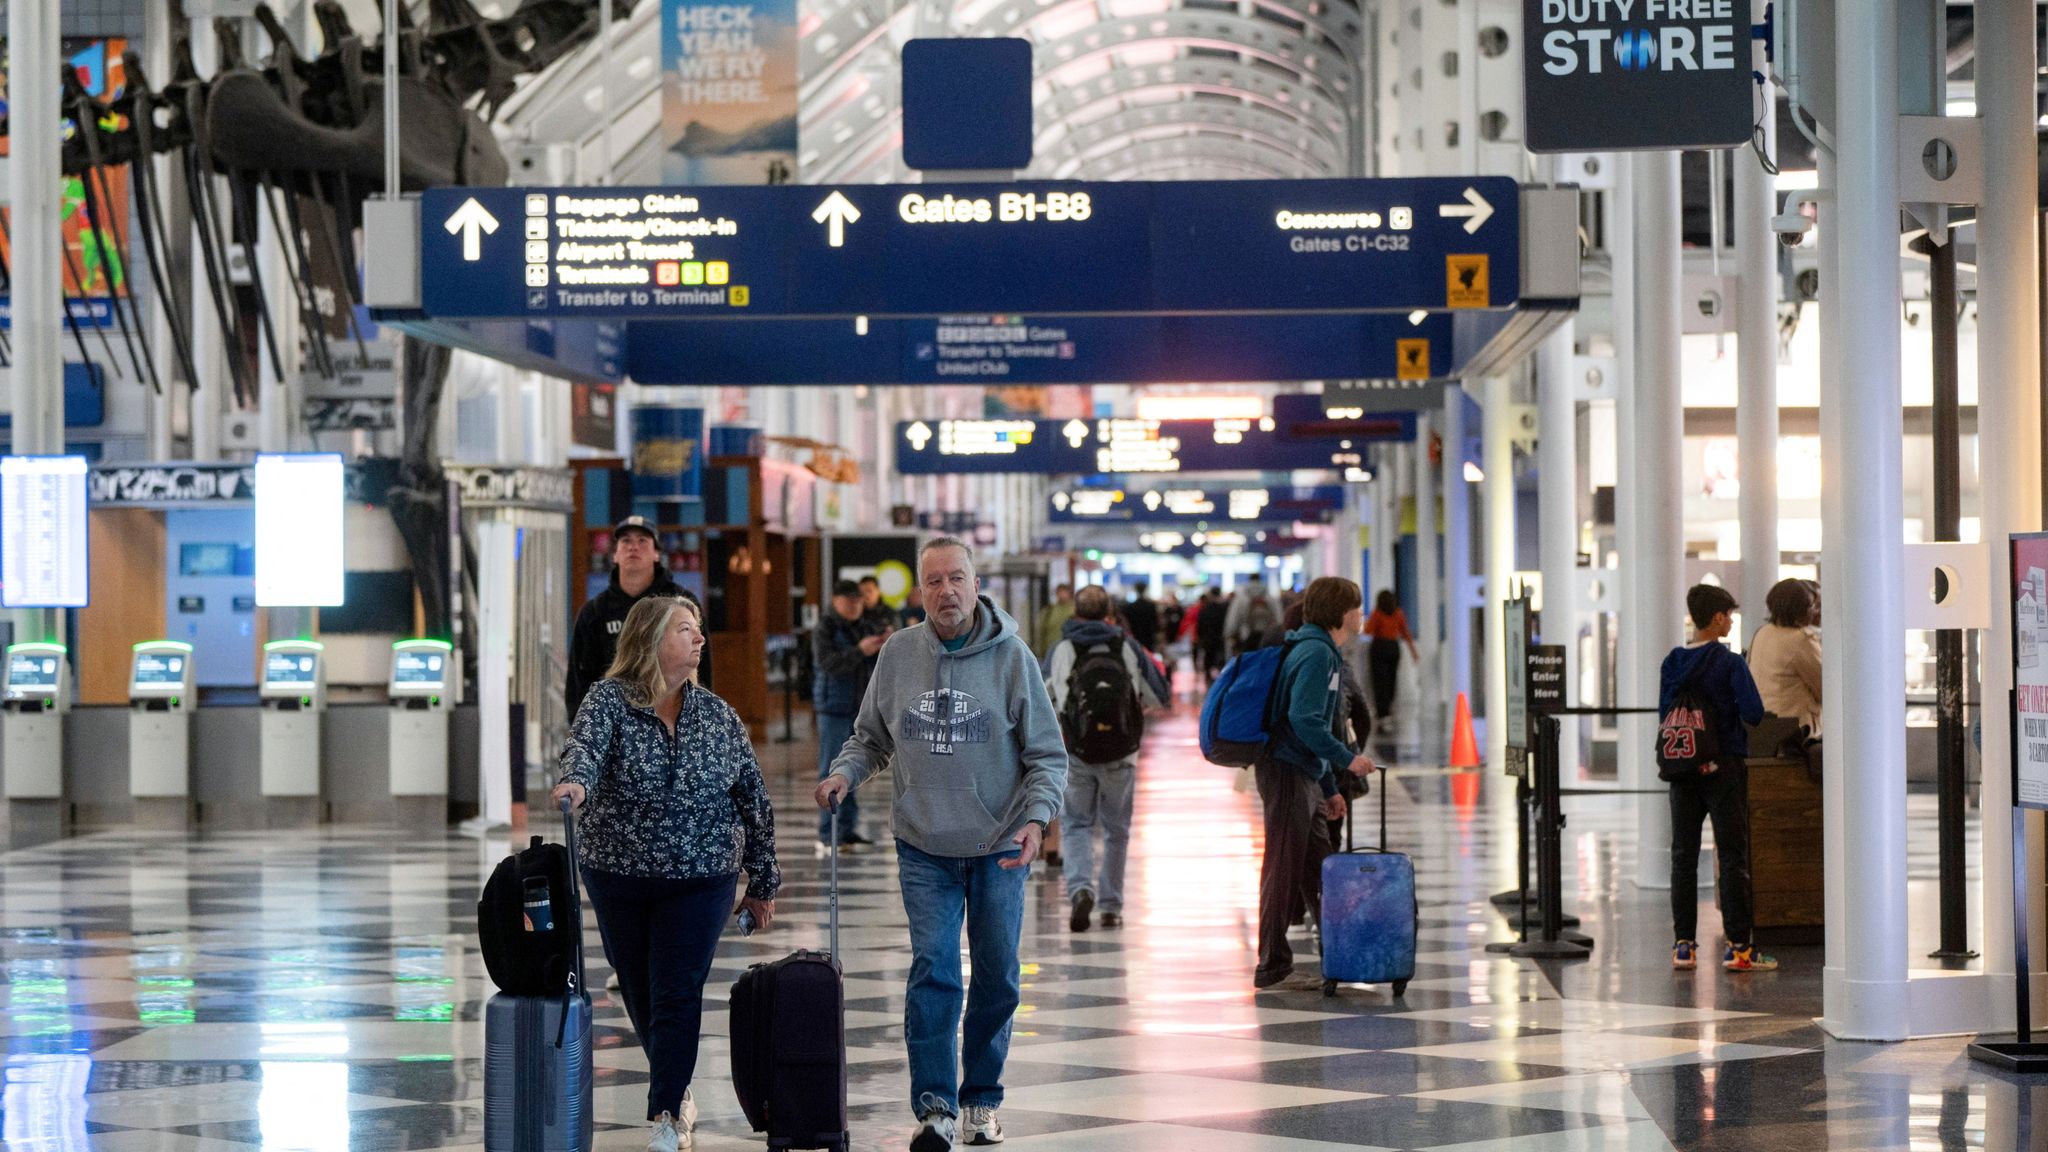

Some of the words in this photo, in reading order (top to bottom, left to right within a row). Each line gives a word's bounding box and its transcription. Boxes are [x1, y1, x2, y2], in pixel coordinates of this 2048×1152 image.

[677, 6, 753, 29] HECK
[1542, 0, 1633, 23] DUTY
[1647, 0, 1732, 20] FREE
[555, 195, 640, 217] Baggage
[642, 194, 699, 213] Claim
[899, 193, 992, 223] Gates
[1000, 192, 1091, 222] B1-B8
[1276, 210, 1381, 230] Concourse
[556, 242, 625, 264] Airport
[626, 241, 694, 260] Transit
[1290, 236, 1341, 252] Gates
[1345, 234, 1410, 251] C1-C32
[555, 265, 649, 284] Terminals
[557, 290, 628, 307] Transfer
[631, 290, 649, 306] to
[652, 288, 725, 306] Terminal
[1528, 655, 1563, 665] Please
[1532, 672, 1560, 682] Enter
[1534, 689, 1559, 698] Here
[2018, 684, 2030, 713] GET
[2031, 685, 2044, 714] ONE
[920, 700, 935, 713] 20
[954, 701, 968, 713] 21
[1662, 727, 1696, 759] 23
